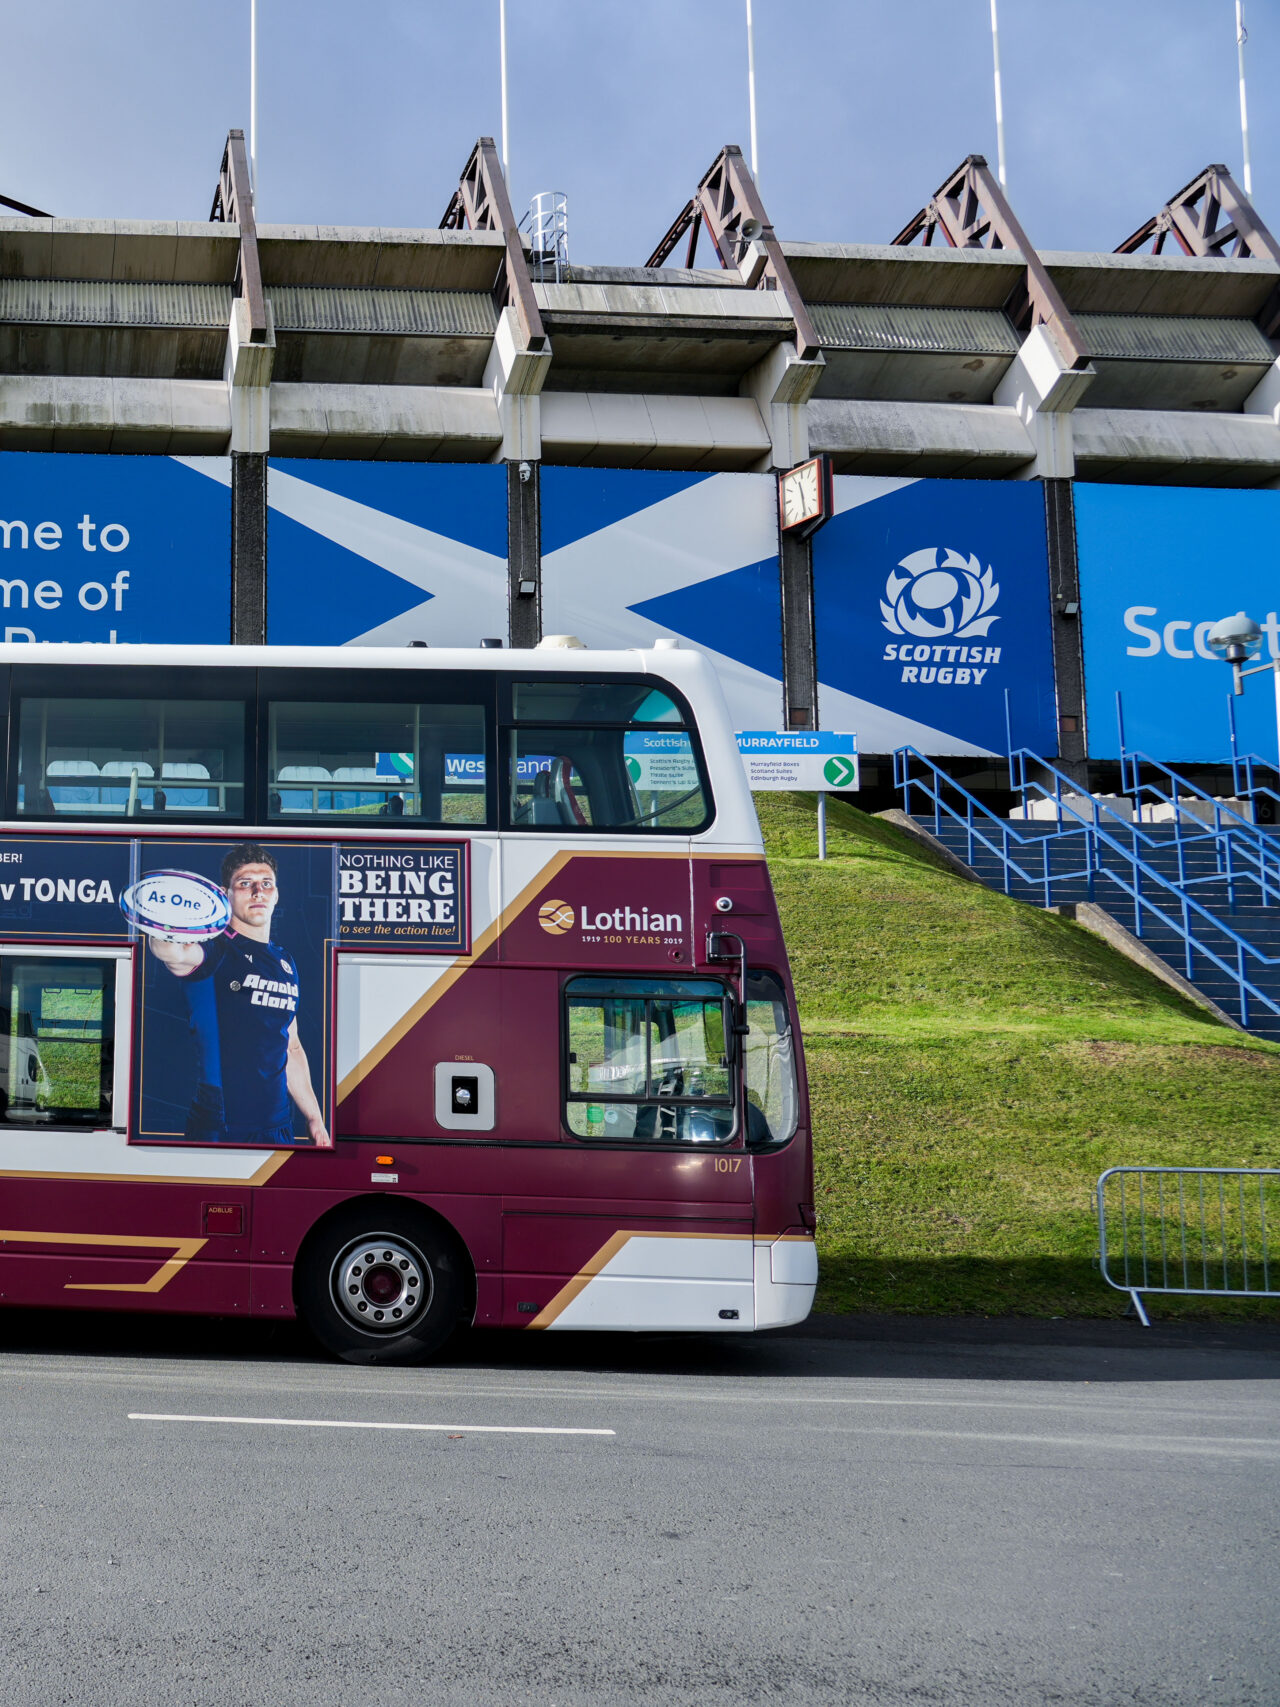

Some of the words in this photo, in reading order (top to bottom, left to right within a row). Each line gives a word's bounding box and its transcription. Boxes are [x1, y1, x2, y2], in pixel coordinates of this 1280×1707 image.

[77, 514, 131, 553] to
[78, 571, 130, 612] of
[882, 643, 1003, 665] SCOTTISH
[900, 666, 989, 686] RUGBY
[643, 738, 687, 748] Scottish
[339, 854, 414, 868] NOTHING
[420, 855, 455, 868] LIKE
[0, 883, 16, 901] v
[19, 877, 115, 904] TONGA
[338, 869, 455, 896] BEING
[148, 890, 166, 904] As
[170, 894, 201, 911] One
[338, 897, 455, 923] THERE
[581, 905, 683, 932] Lothian
[339, 924, 350, 934] to
[353, 926, 371, 935] see
[374, 925, 391, 935] the
[394, 925, 428, 936] action
[431, 925, 456, 936] live!
[603, 935, 622, 943] 100
[625, 936, 661, 945] YEARS
[663, 937, 683, 945] 2019
[242, 973, 299, 998] Arnold
[250, 990, 297, 1012] Clark
[714, 1157, 742, 1173] 1017
